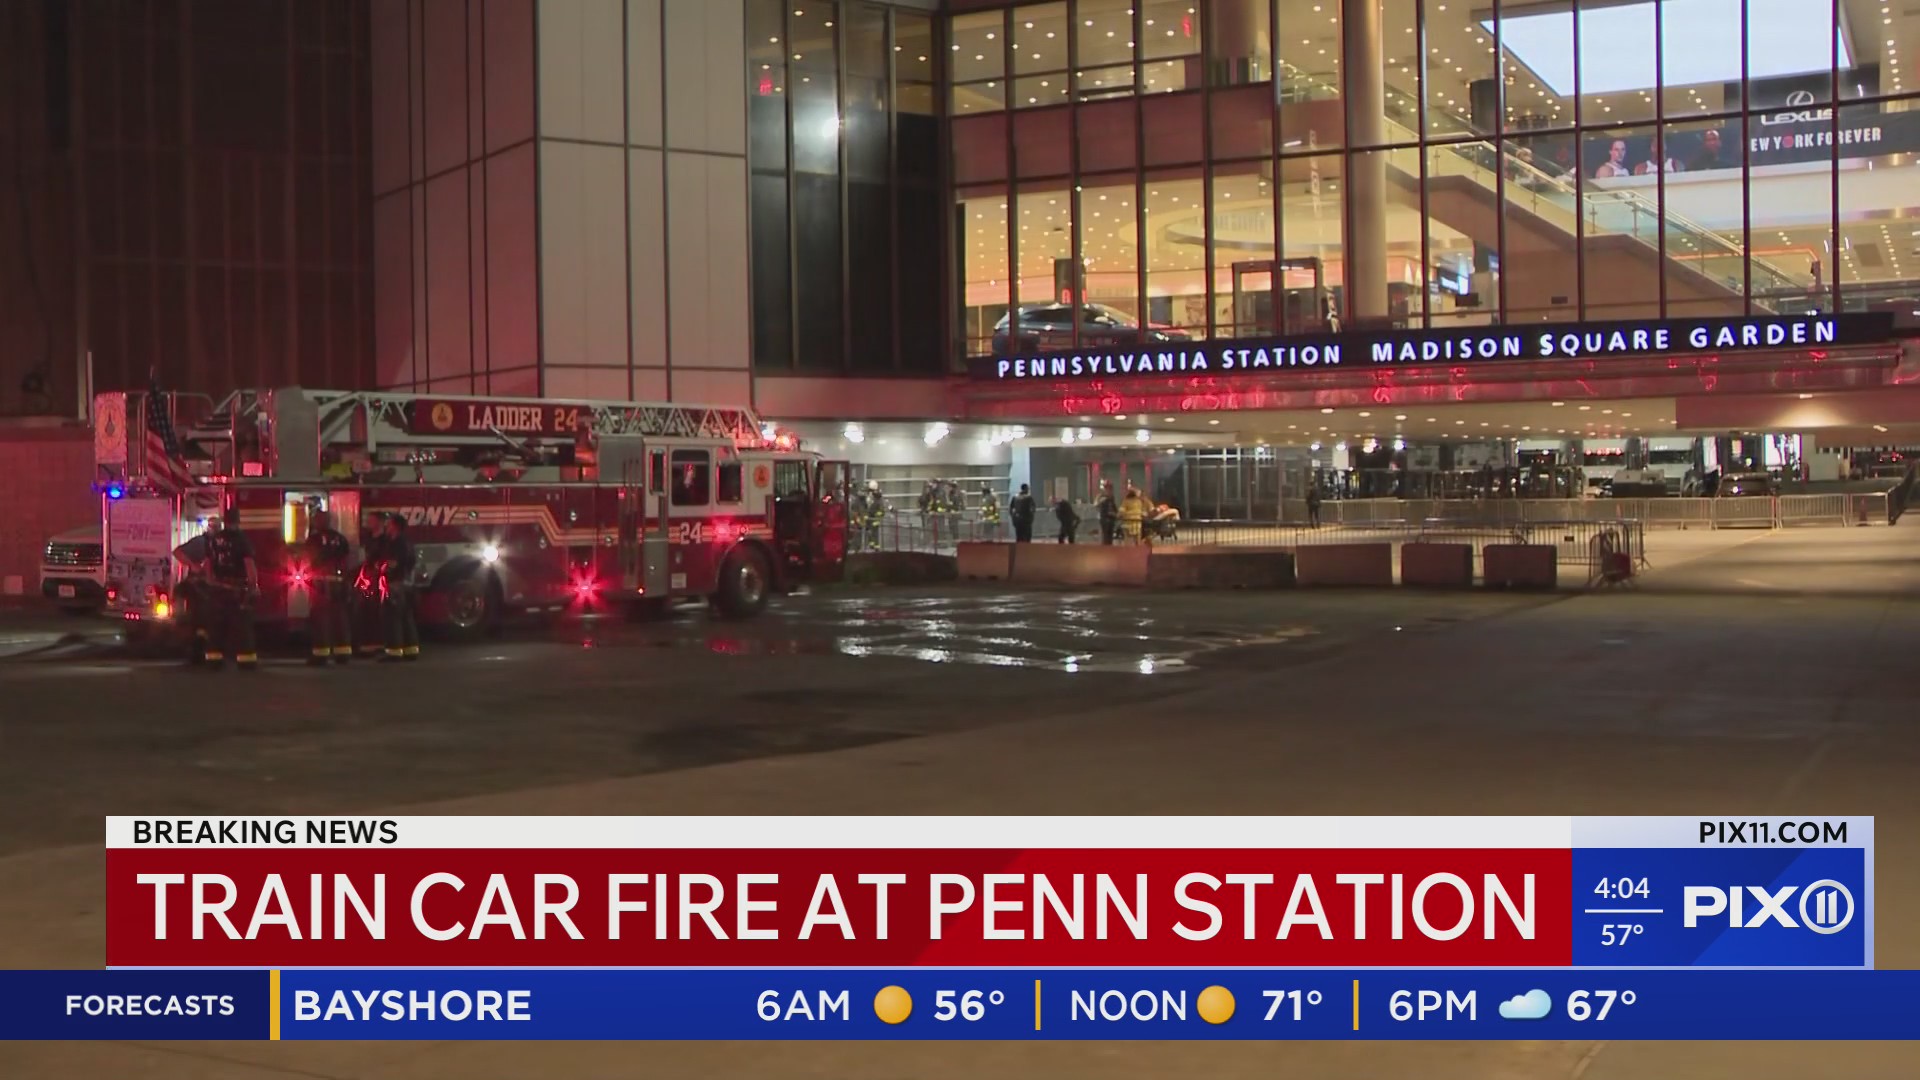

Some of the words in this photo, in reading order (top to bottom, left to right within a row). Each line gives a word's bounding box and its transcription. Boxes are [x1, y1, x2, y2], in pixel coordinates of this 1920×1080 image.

[1760, 108, 1833, 126] LEXUS
[1750, 136, 1770, 152] EW
[1773, 133, 1814, 149] YORK
[1817, 127, 1882, 146] FOREVER
[998, 350, 1208, 378] PENNSYLVANIA
[1222, 344, 1341, 369] STATION
[1372, 336, 1521, 362] MADISON
[1540, 329, 1669, 357] SQUARE
[1690, 321, 1836, 349] GARDEN
[468, 404, 543, 431] LADDER
[554, 408, 578, 432] 24
[680, 521, 702, 545] 24
